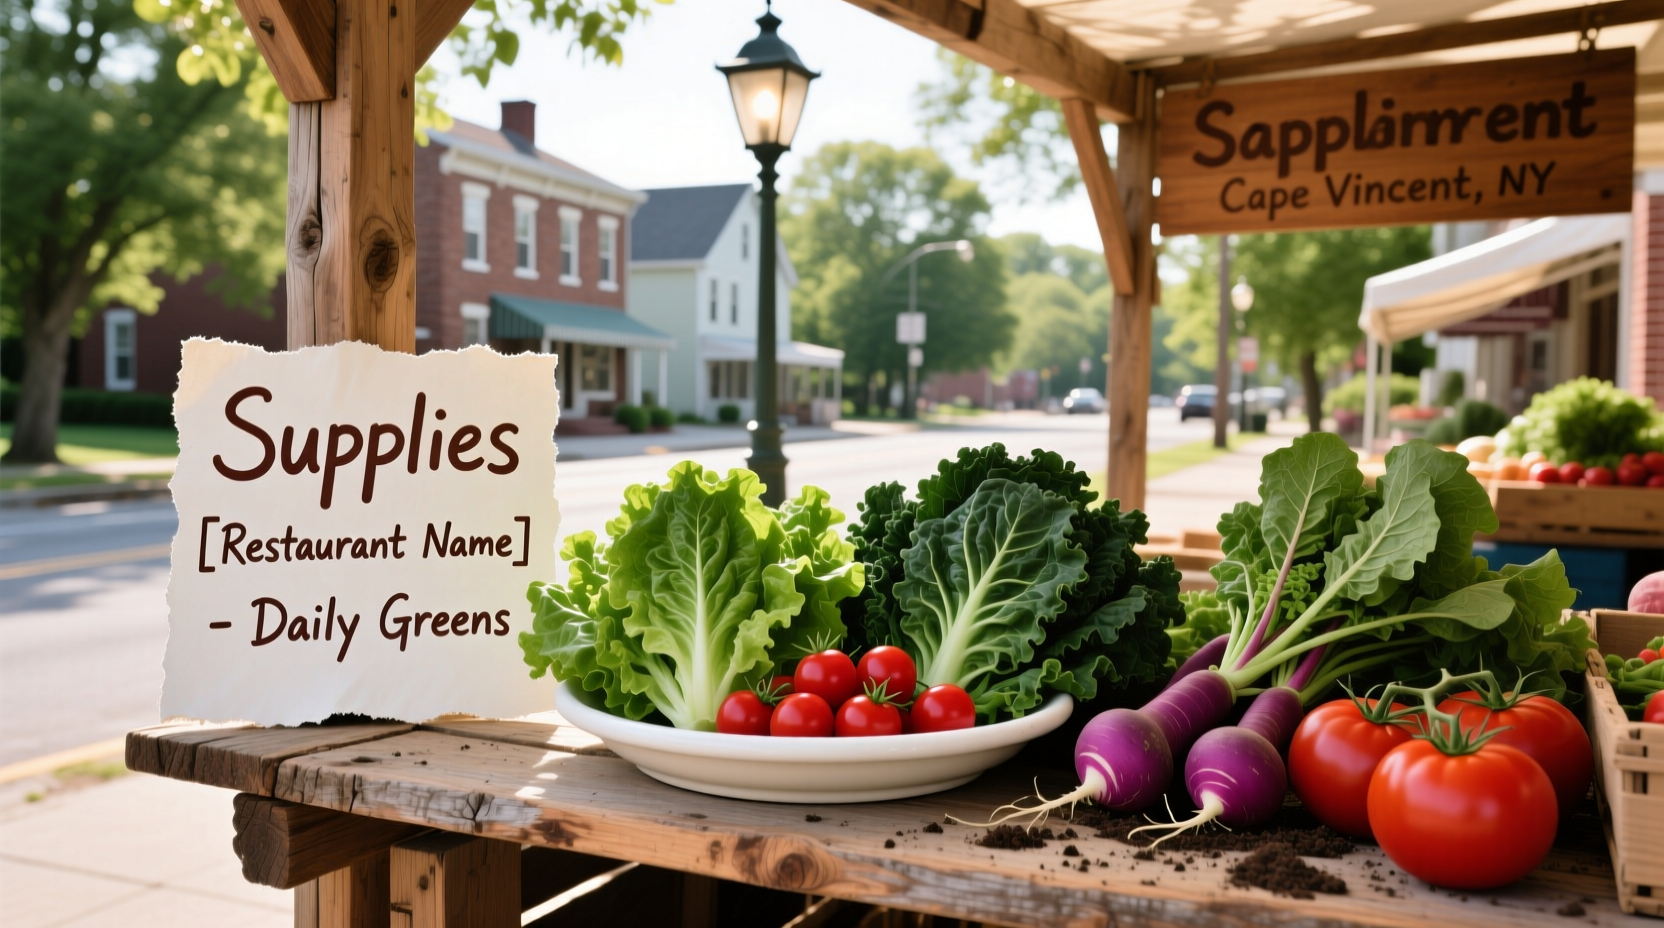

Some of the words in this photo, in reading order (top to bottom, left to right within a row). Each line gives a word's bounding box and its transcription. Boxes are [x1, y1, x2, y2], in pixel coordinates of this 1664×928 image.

[1219, 176, 1310, 221] Cape
[1324, 166, 1483, 208] Vincent,
[1498, 161, 1557, 197] NY
[213, 386, 520, 510] Supplies
[199, 516, 407, 573] [Restaurant
[423, 516, 531, 567] Name]
[251, 595, 361, 664] Daily
[380, 593, 511, 652] Greens
